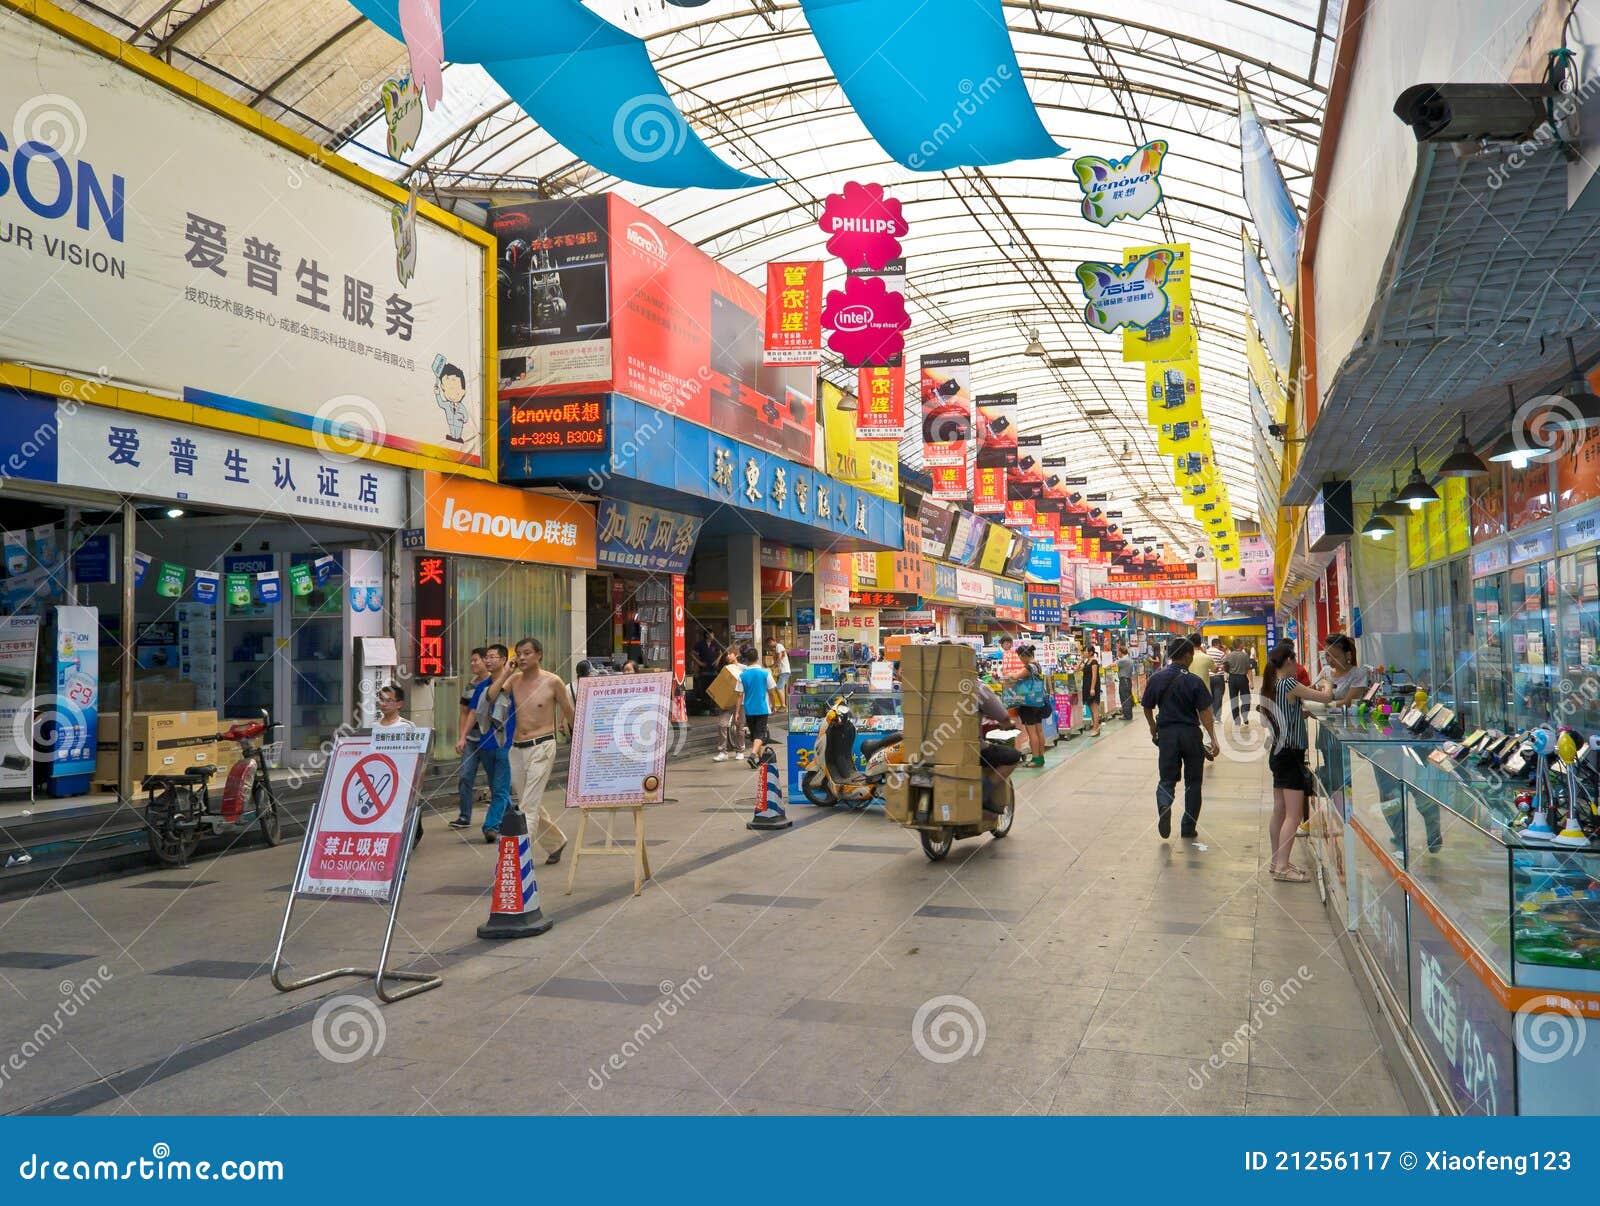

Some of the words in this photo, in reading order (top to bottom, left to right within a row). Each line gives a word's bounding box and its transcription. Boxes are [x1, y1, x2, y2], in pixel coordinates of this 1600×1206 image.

[0, 138, 125, 243] ON
[1091, 174, 1150, 193] lenovo
[1112, 187, 1136, 200] 联想
[832, 216, 896, 234] PHILIPS
[43, 234, 125, 280] VISION
[184, 212, 414, 342] 爱普生服务
[1100, 280, 1145, 297] ASUS
[781, 266, 807, 332] 管家婆
[840, 310, 867, 324] intel
[107, 426, 378, 505] 爱普生认证店
[404, 535, 424, 546] 101
[233, 561, 266, 572] EPSON
[835, 616, 875, 627] 动专区
[824, 633, 835, 642] 3G
[323, 836, 390, 857] 禁止吸烟
[320, 859, 335, 870] NO
[337, 860, 385, 872] SMOKING
